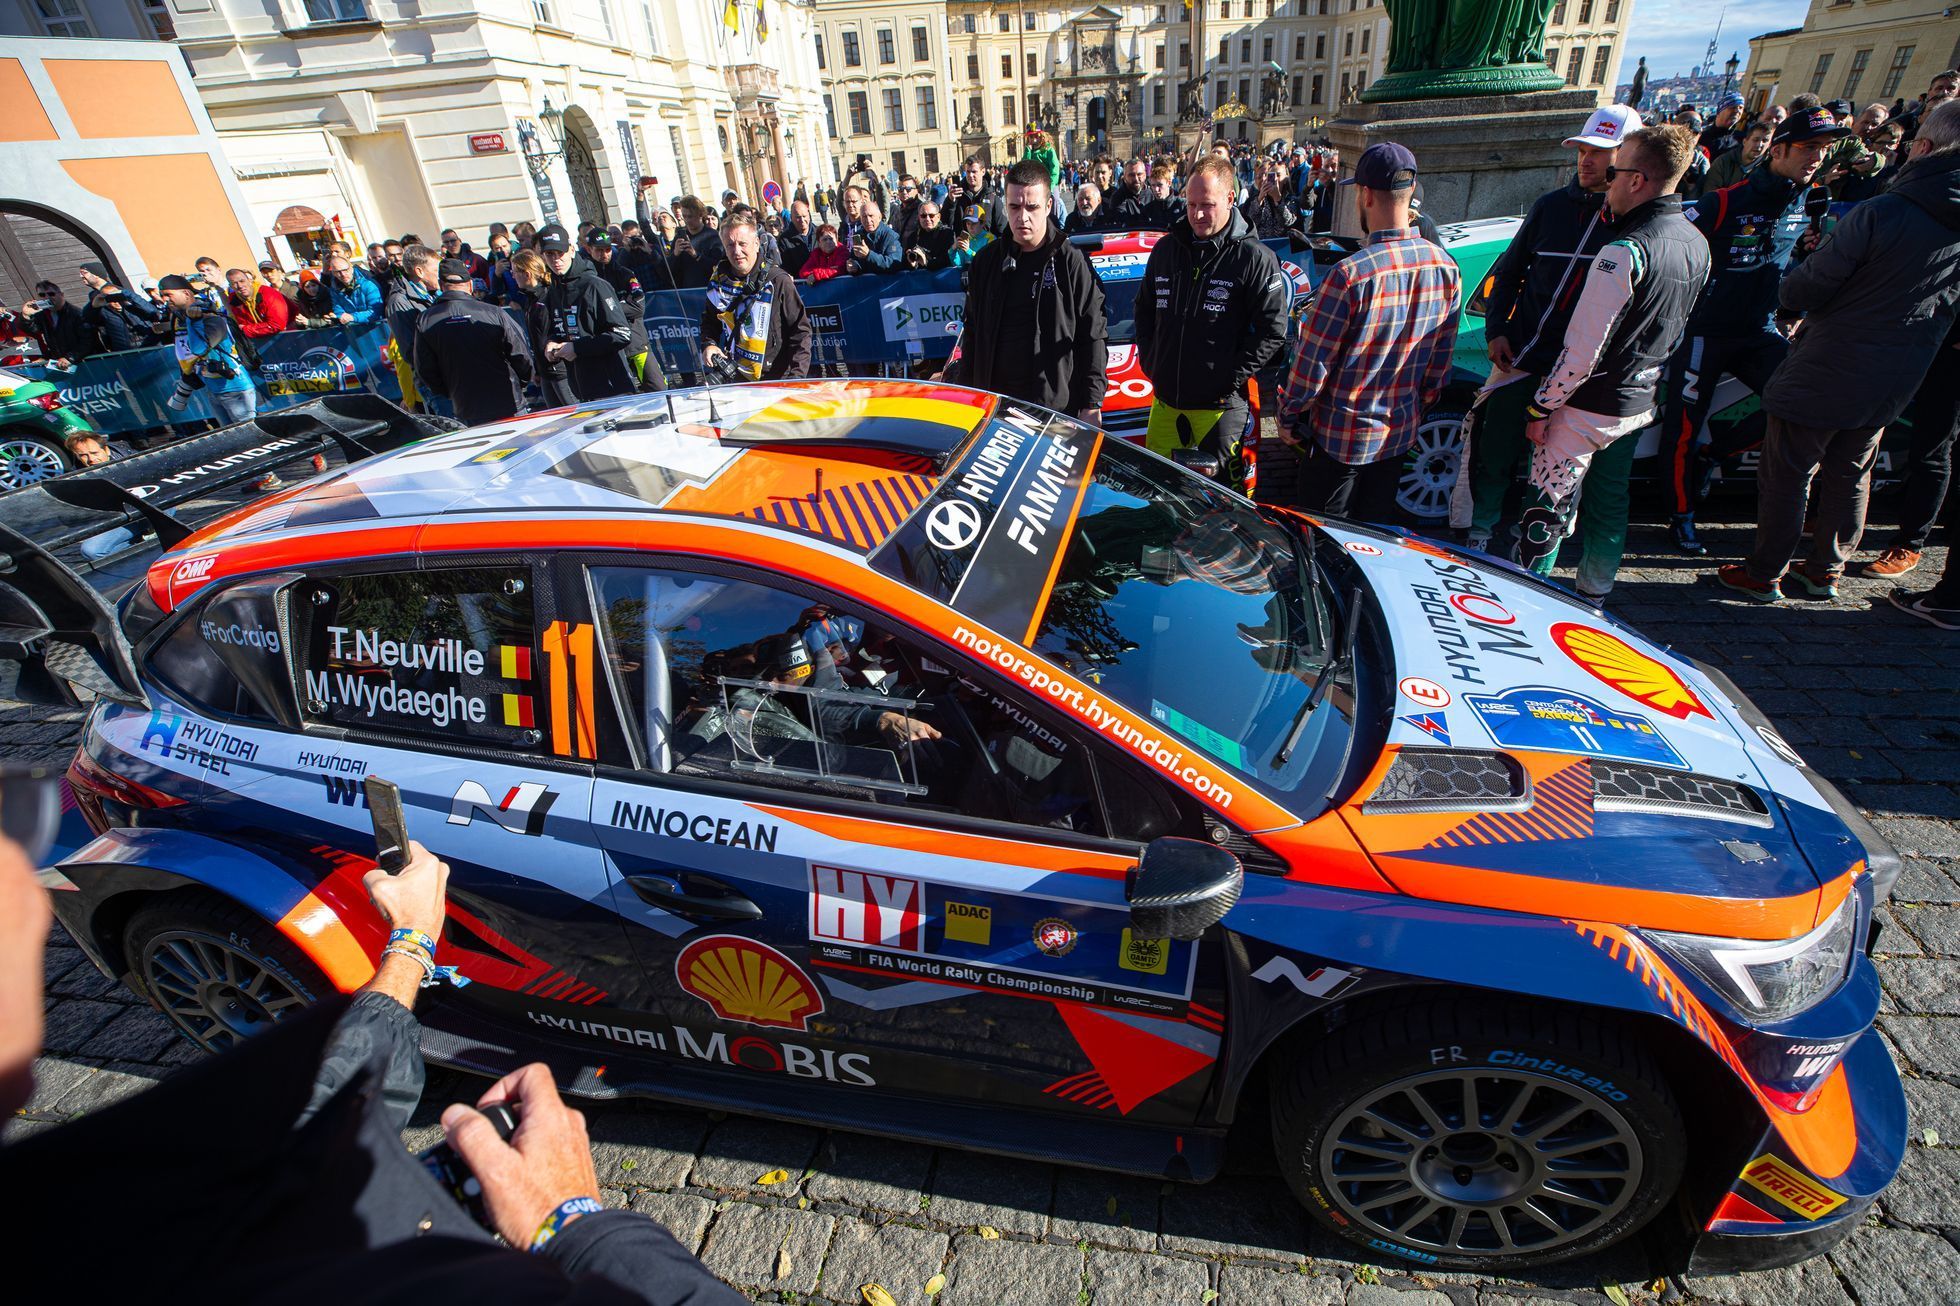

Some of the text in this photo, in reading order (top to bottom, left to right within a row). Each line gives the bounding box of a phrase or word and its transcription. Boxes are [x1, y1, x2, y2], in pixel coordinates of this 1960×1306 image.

[1810, 118, 1836, 128] Red Bull
[1741, 216, 1764, 225] MBIS
[1598, 261, 1616, 270] OMP
[260, 361, 316, 373] CENTRAL
[264, 370, 328, 383] EUROPEAN
[269, 380, 323, 395] RALLY
[161, 439, 298, 484] HYUNDAI
[957, 427, 1025, 502] HYUNDAI
[1007, 434, 1079, 555] FANATEC
[177, 558, 216, 579] OMP
[1425, 558, 1544, 665] MOBIS
[200, 620, 280, 653] #ForCraig
[327, 626, 485, 676] T.Neuville
[1410, 583, 1485, 685] HYUNDAI
[305, 669, 487, 727] M.Wydaeghe
[542, 620, 597, 760] 11
[1476, 702, 1518, 712] WRC
[1524, 700, 1567, 710] CENTRAL
[952, 626, 1233, 809] motorsport.hyundai.com
[991, 697, 1067, 752] HYUNDAI
[1569, 724, 1603, 751] 11
[175, 743, 231, 776] STEEL
[181, 721, 259, 762] HYUNDAI
[298, 752, 368, 775] HYUNDAI
[610, 800, 778, 852] INNOCEAN
[816, 867, 915, 947] HY
[948, 903, 990, 920] ADAC
[869, 954, 894, 968] FIA
[897, 958, 940, 975] World
[945, 966, 983, 984] Rally
[987, 972, 1095, 1001] Championship
[527, 1011, 666, 1051] HYUNDAI
[1786, 1042, 1845, 1055] HYUNDAI
[672, 1025, 877, 1088] MOBIS
[1430, 1045, 1468, 1065] FR
[1487, 1049, 1629, 1102] Cinturato
[1747, 1161, 1834, 1213] PIRELLI
